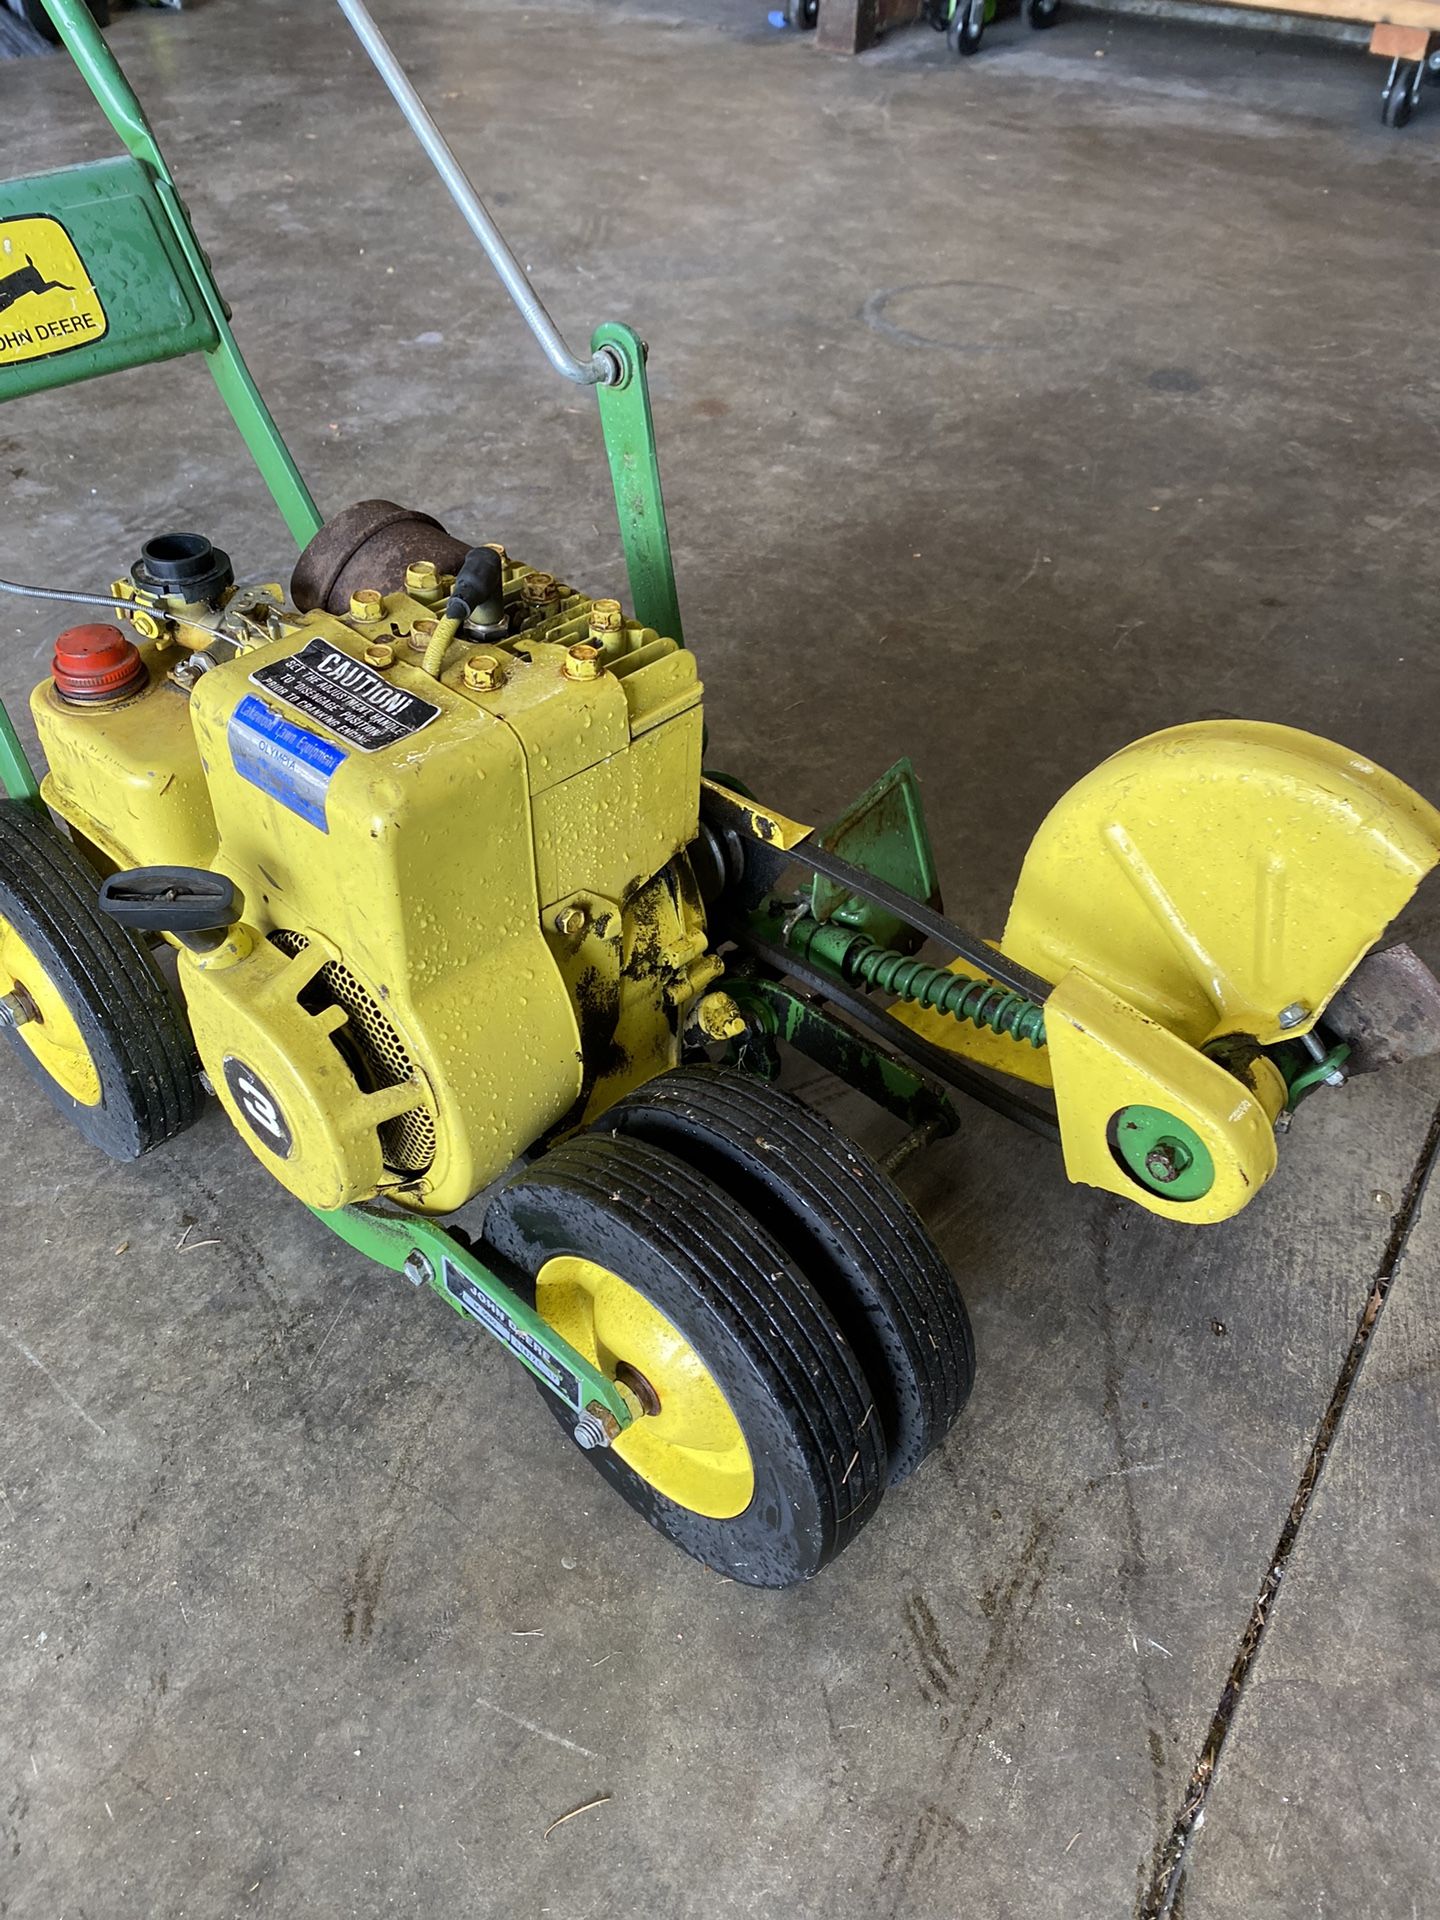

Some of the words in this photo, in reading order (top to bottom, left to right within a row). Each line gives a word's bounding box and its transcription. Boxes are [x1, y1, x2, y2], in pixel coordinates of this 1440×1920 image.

[0, 329, 33, 352] OHN
[34, 312, 97, 341] DEERE
[262, 678, 289, 695] PRIOR
[286, 692, 300, 703] TO
[297, 700, 341, 728] CRANKING
[281, 673, 295, 684] TO
[285, 660, 306, 673] SET
[302, 671, 323, 685] THE
[316, 682, 375, 717] ADJUSTMENT
[370, 713, 406, 735] HANDLE
[317, 653, 414, 716] CAUTION!
[239, 700, 278, 732] Lakewood
[274, 721, 298, 745] Lawn
[295, 735, 337, 769] Equipment
[258, 740, 297, 770] OLYMPIA
[238, 1077, 281, 1138] 3
[470, 1287, 506, 1322] JOHN
[508, 1319, 552, 1364] DERE
